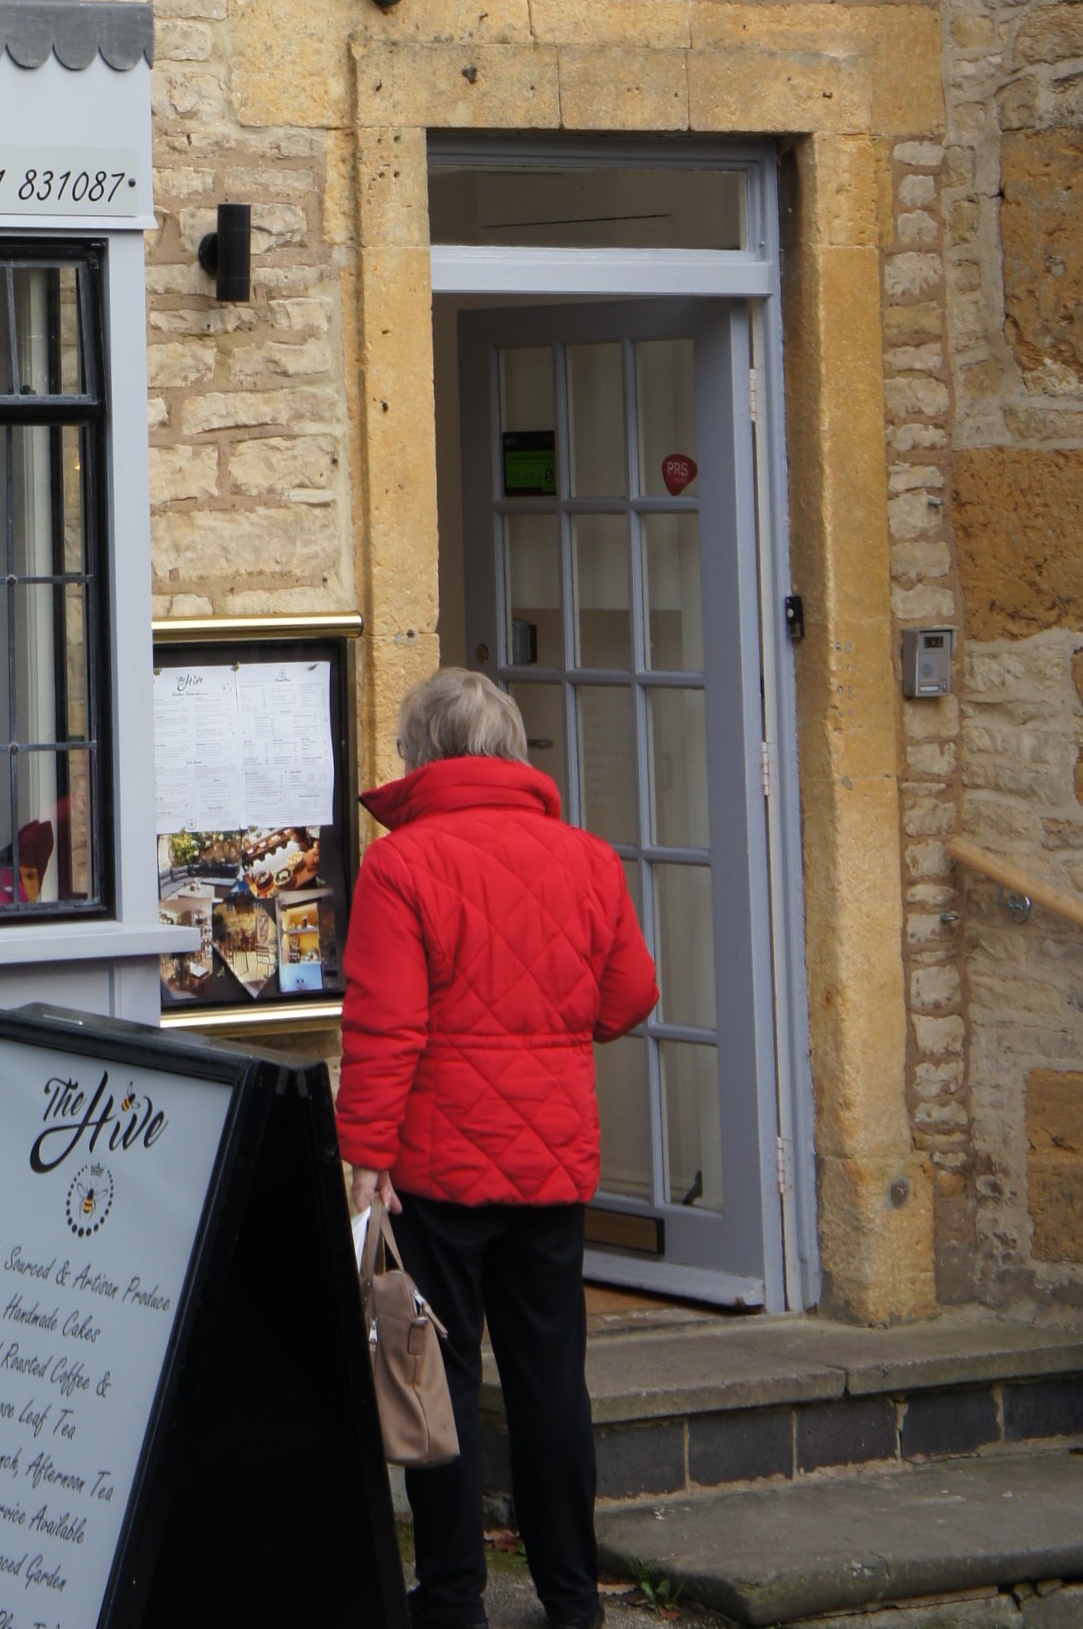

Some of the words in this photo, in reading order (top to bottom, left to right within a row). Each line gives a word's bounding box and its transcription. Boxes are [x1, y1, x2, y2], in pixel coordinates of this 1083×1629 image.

[18, 168, 126, 203] 831087
[667, 460, 689, 477] PRS
[29, 1070, 169, 1174] Hive
[43, 1076, 88, 1122] The
[4, 1246, 57, 1280] Sourced
[55, 1261, 71, 1287] &
[72, 1264, 119, 1300] Artisan
[122, 1276, 171, 1312] Produce
[2, 1292, 60, 1332] Handmade
[62, 1310, 101, 1343] Cakes
[1, 1343, 54, 1379] Roasted
[50, 1356, 90, 1397] Coffee
[95, 1371, 112, 1399] &
[18, 1399, 53, 1438] Leaf
[53, 1409, 76, 1441] Tea
[25, 1451, 86, 1493] Afternoon
[90, 1471, 115, 1502] Tea
[28, 1504, 87, 1545] Available
[24, 1554, 68, 1593] Garden
